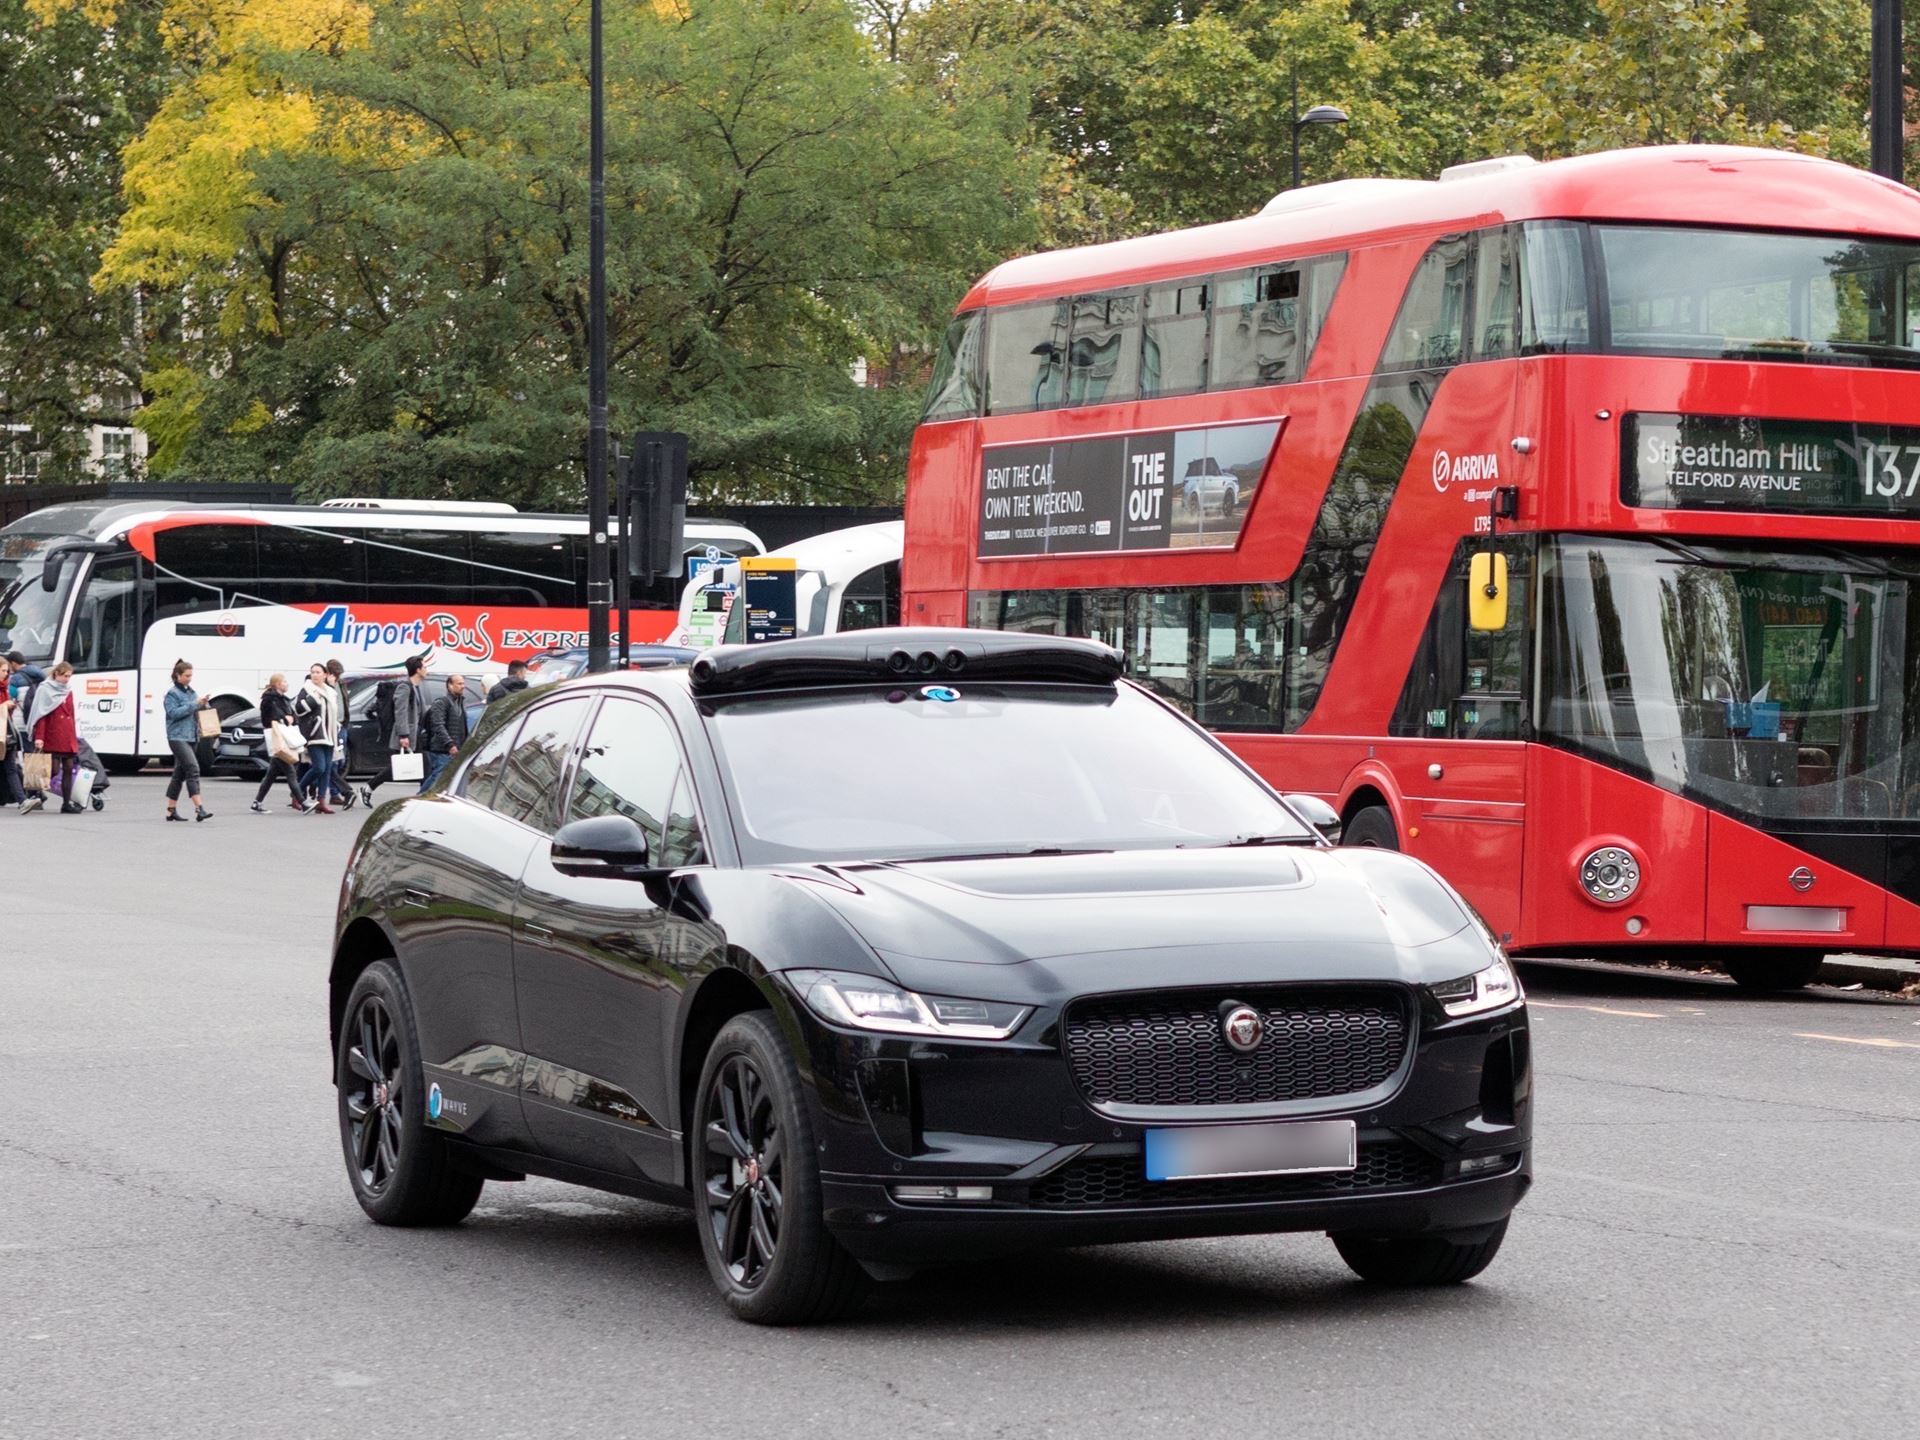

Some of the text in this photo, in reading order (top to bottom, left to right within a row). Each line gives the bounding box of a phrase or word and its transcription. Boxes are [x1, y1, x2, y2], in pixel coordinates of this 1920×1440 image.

[1132, 452, 1166, 486] THE
[1451, 454, 1499, 481] ARRIVA
[1646, 436, 1822, 472] Streatham Hill
[986, 463, 1056, 490] RENT THE CAR.
[1666, 470, 1802, 491] TELFORD AVENUE
[1863, 443, 1920, 497] 137
[985, 490, 1085, 519] OWN THE WEEKEND.
[1128, 488, 1164, 522] OUT
[303, 606, 620, 663] Airport Bus EXPRES
[78, 701, 95, 710] Free
